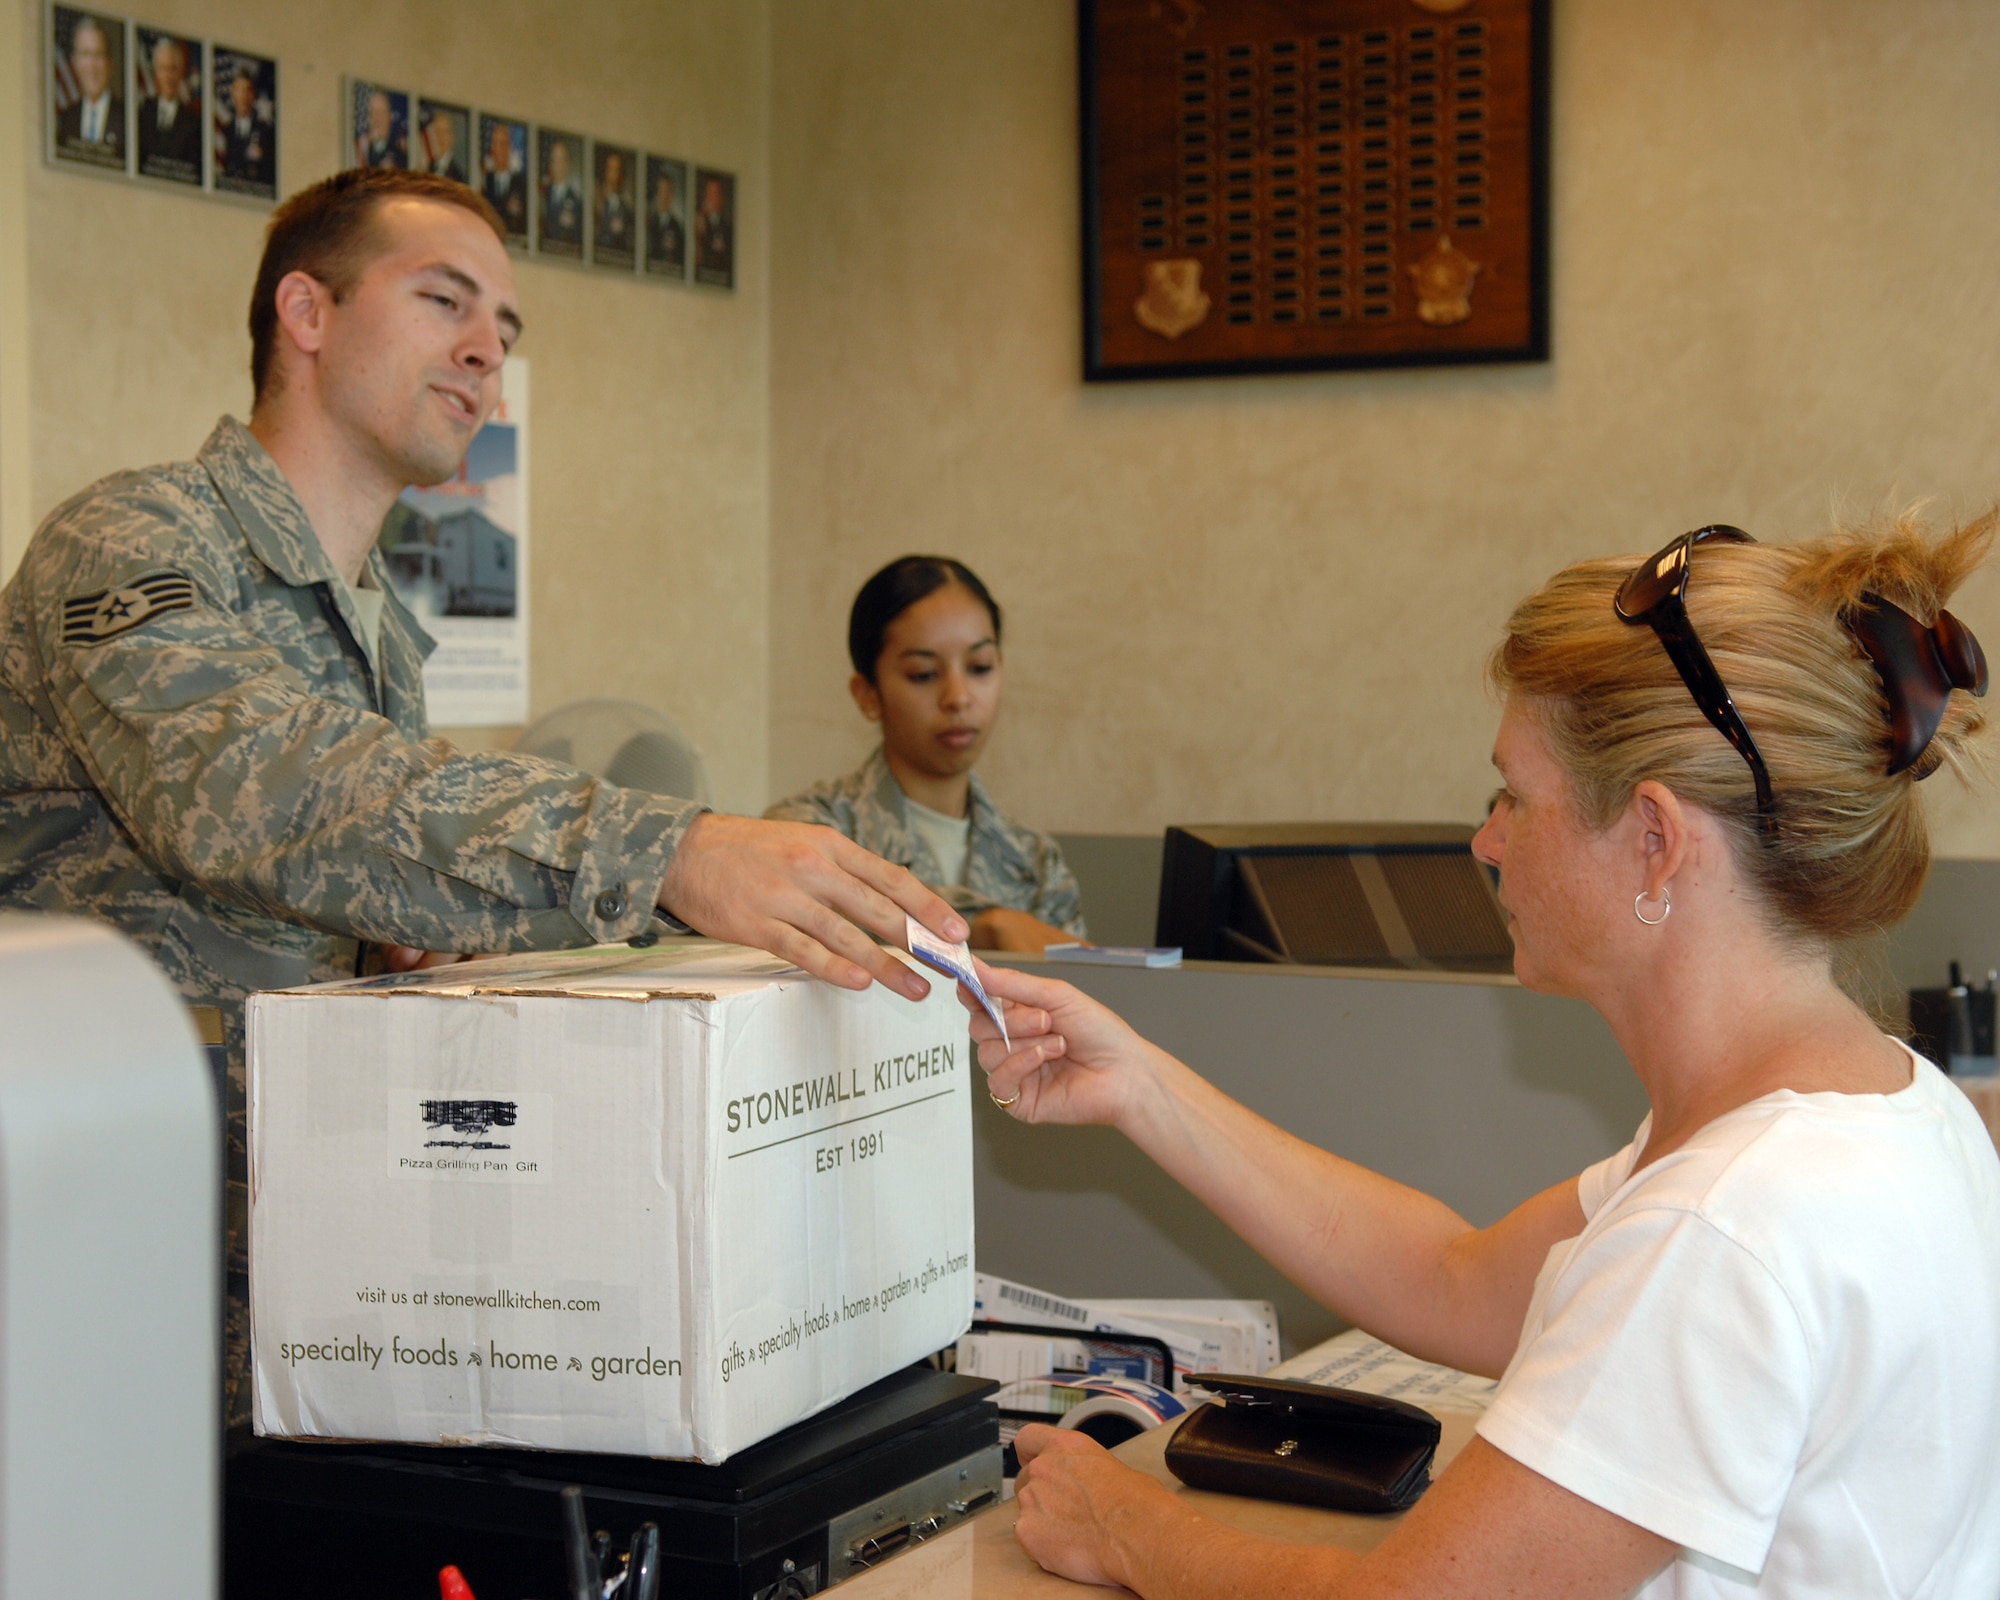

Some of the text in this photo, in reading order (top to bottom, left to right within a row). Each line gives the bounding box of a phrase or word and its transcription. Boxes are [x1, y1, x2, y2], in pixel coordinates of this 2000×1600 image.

[726, 1042, 955, 1134] STONEWALL KITCHEN
[399, 1158, 538, 1172] Pizza Grilling Pan Gift
[850, 1130, 885, 1163] 1991
[356, 1287, 600, 1313] visit us at stonewallkitchen.com
[722, 1251, 968, 1383] gifts specialty foods home garden gifts home
[280, 1335, 682, 1382] specialty foods home garden
